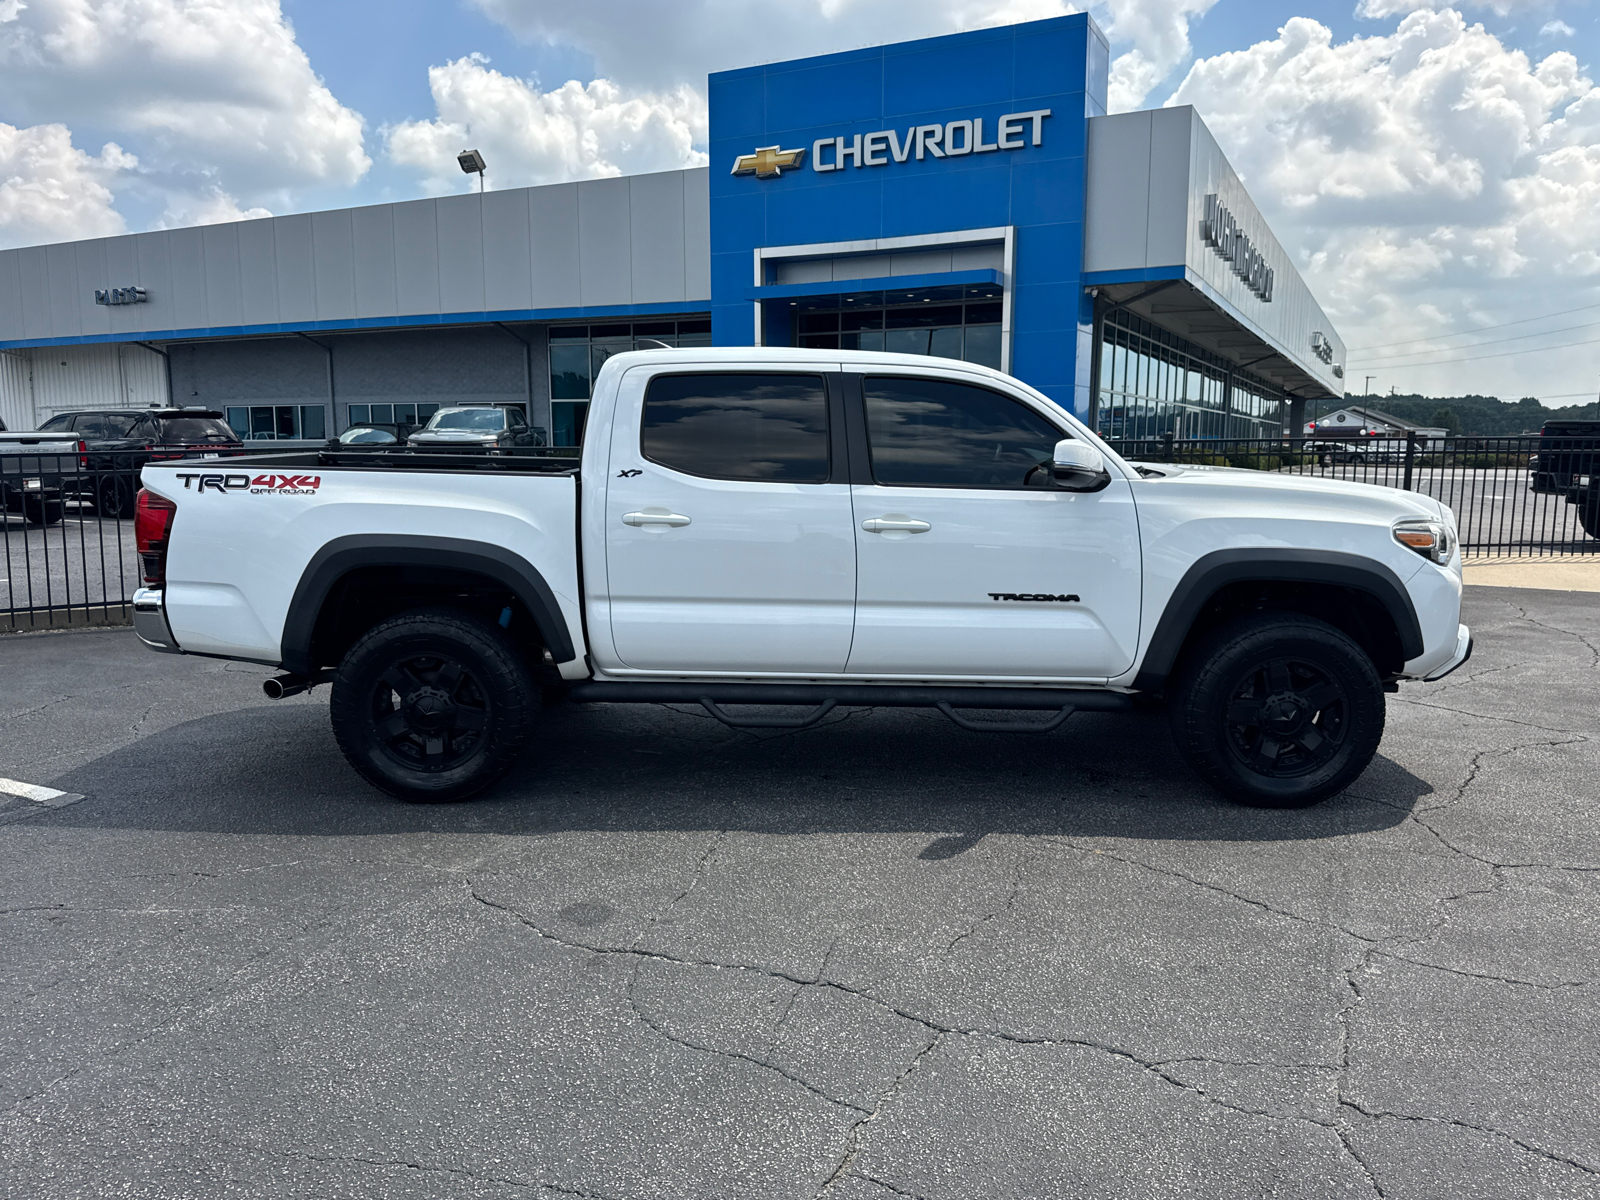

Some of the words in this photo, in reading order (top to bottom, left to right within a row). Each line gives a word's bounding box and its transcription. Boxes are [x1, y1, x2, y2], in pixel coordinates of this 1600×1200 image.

[812, 108, 1051, 172] CHEVROLET
[95, 286, 141, 305] PARTS
[616, 469, 643, 478] XP
[176, 473, 251, 494] TRD
[987, 592, 1081, 602] TACOMA
